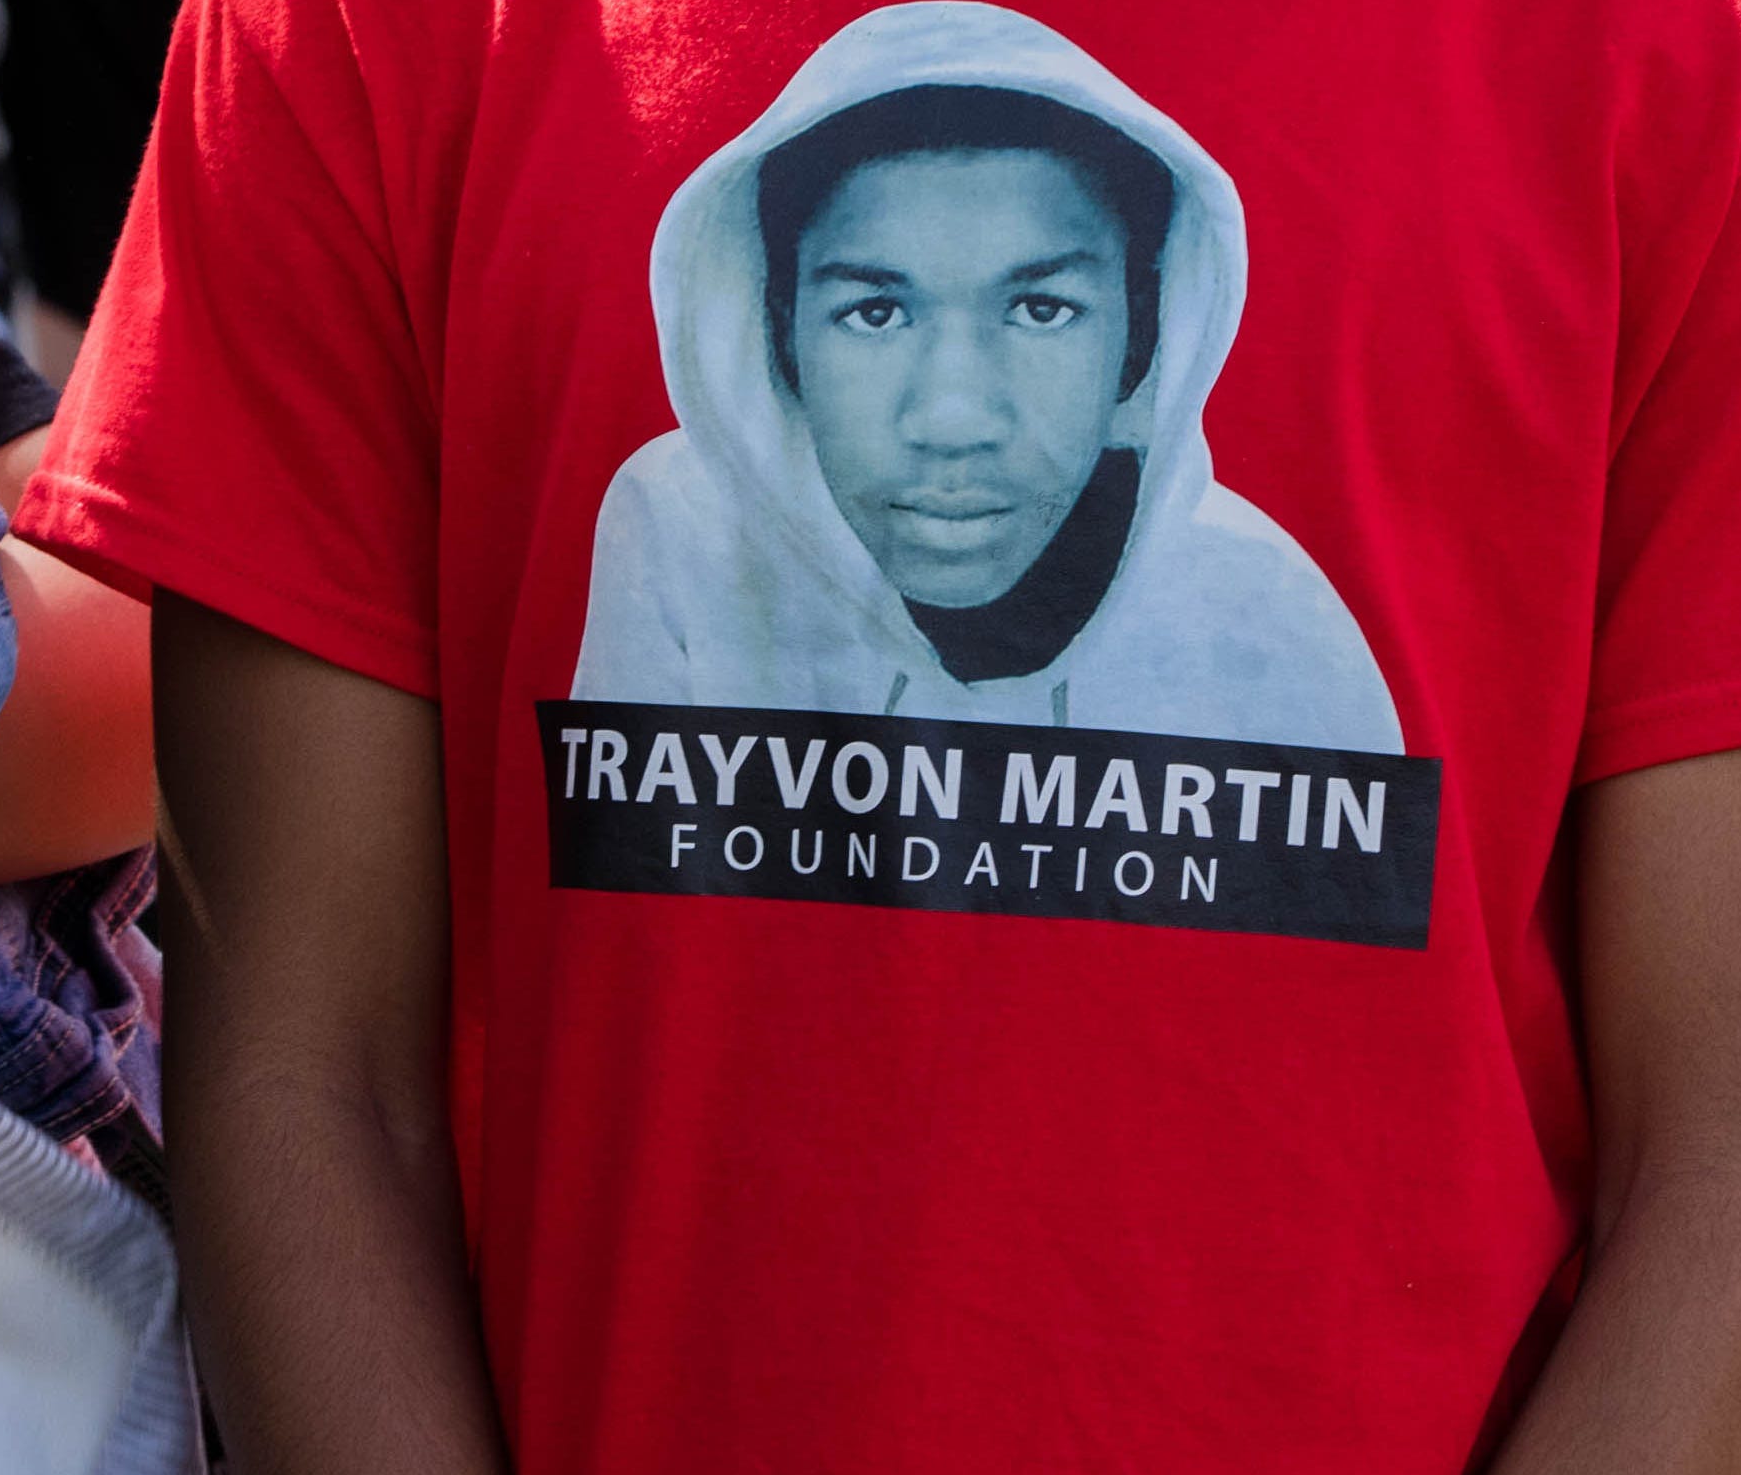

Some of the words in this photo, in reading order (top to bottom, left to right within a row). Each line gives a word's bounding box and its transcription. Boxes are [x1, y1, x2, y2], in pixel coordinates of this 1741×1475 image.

[561, 727, 963, 820] TRAYVON
[998, 751, 1387, 854] MARTIN
[669, 822, 1220, 904] FOUNDATION
